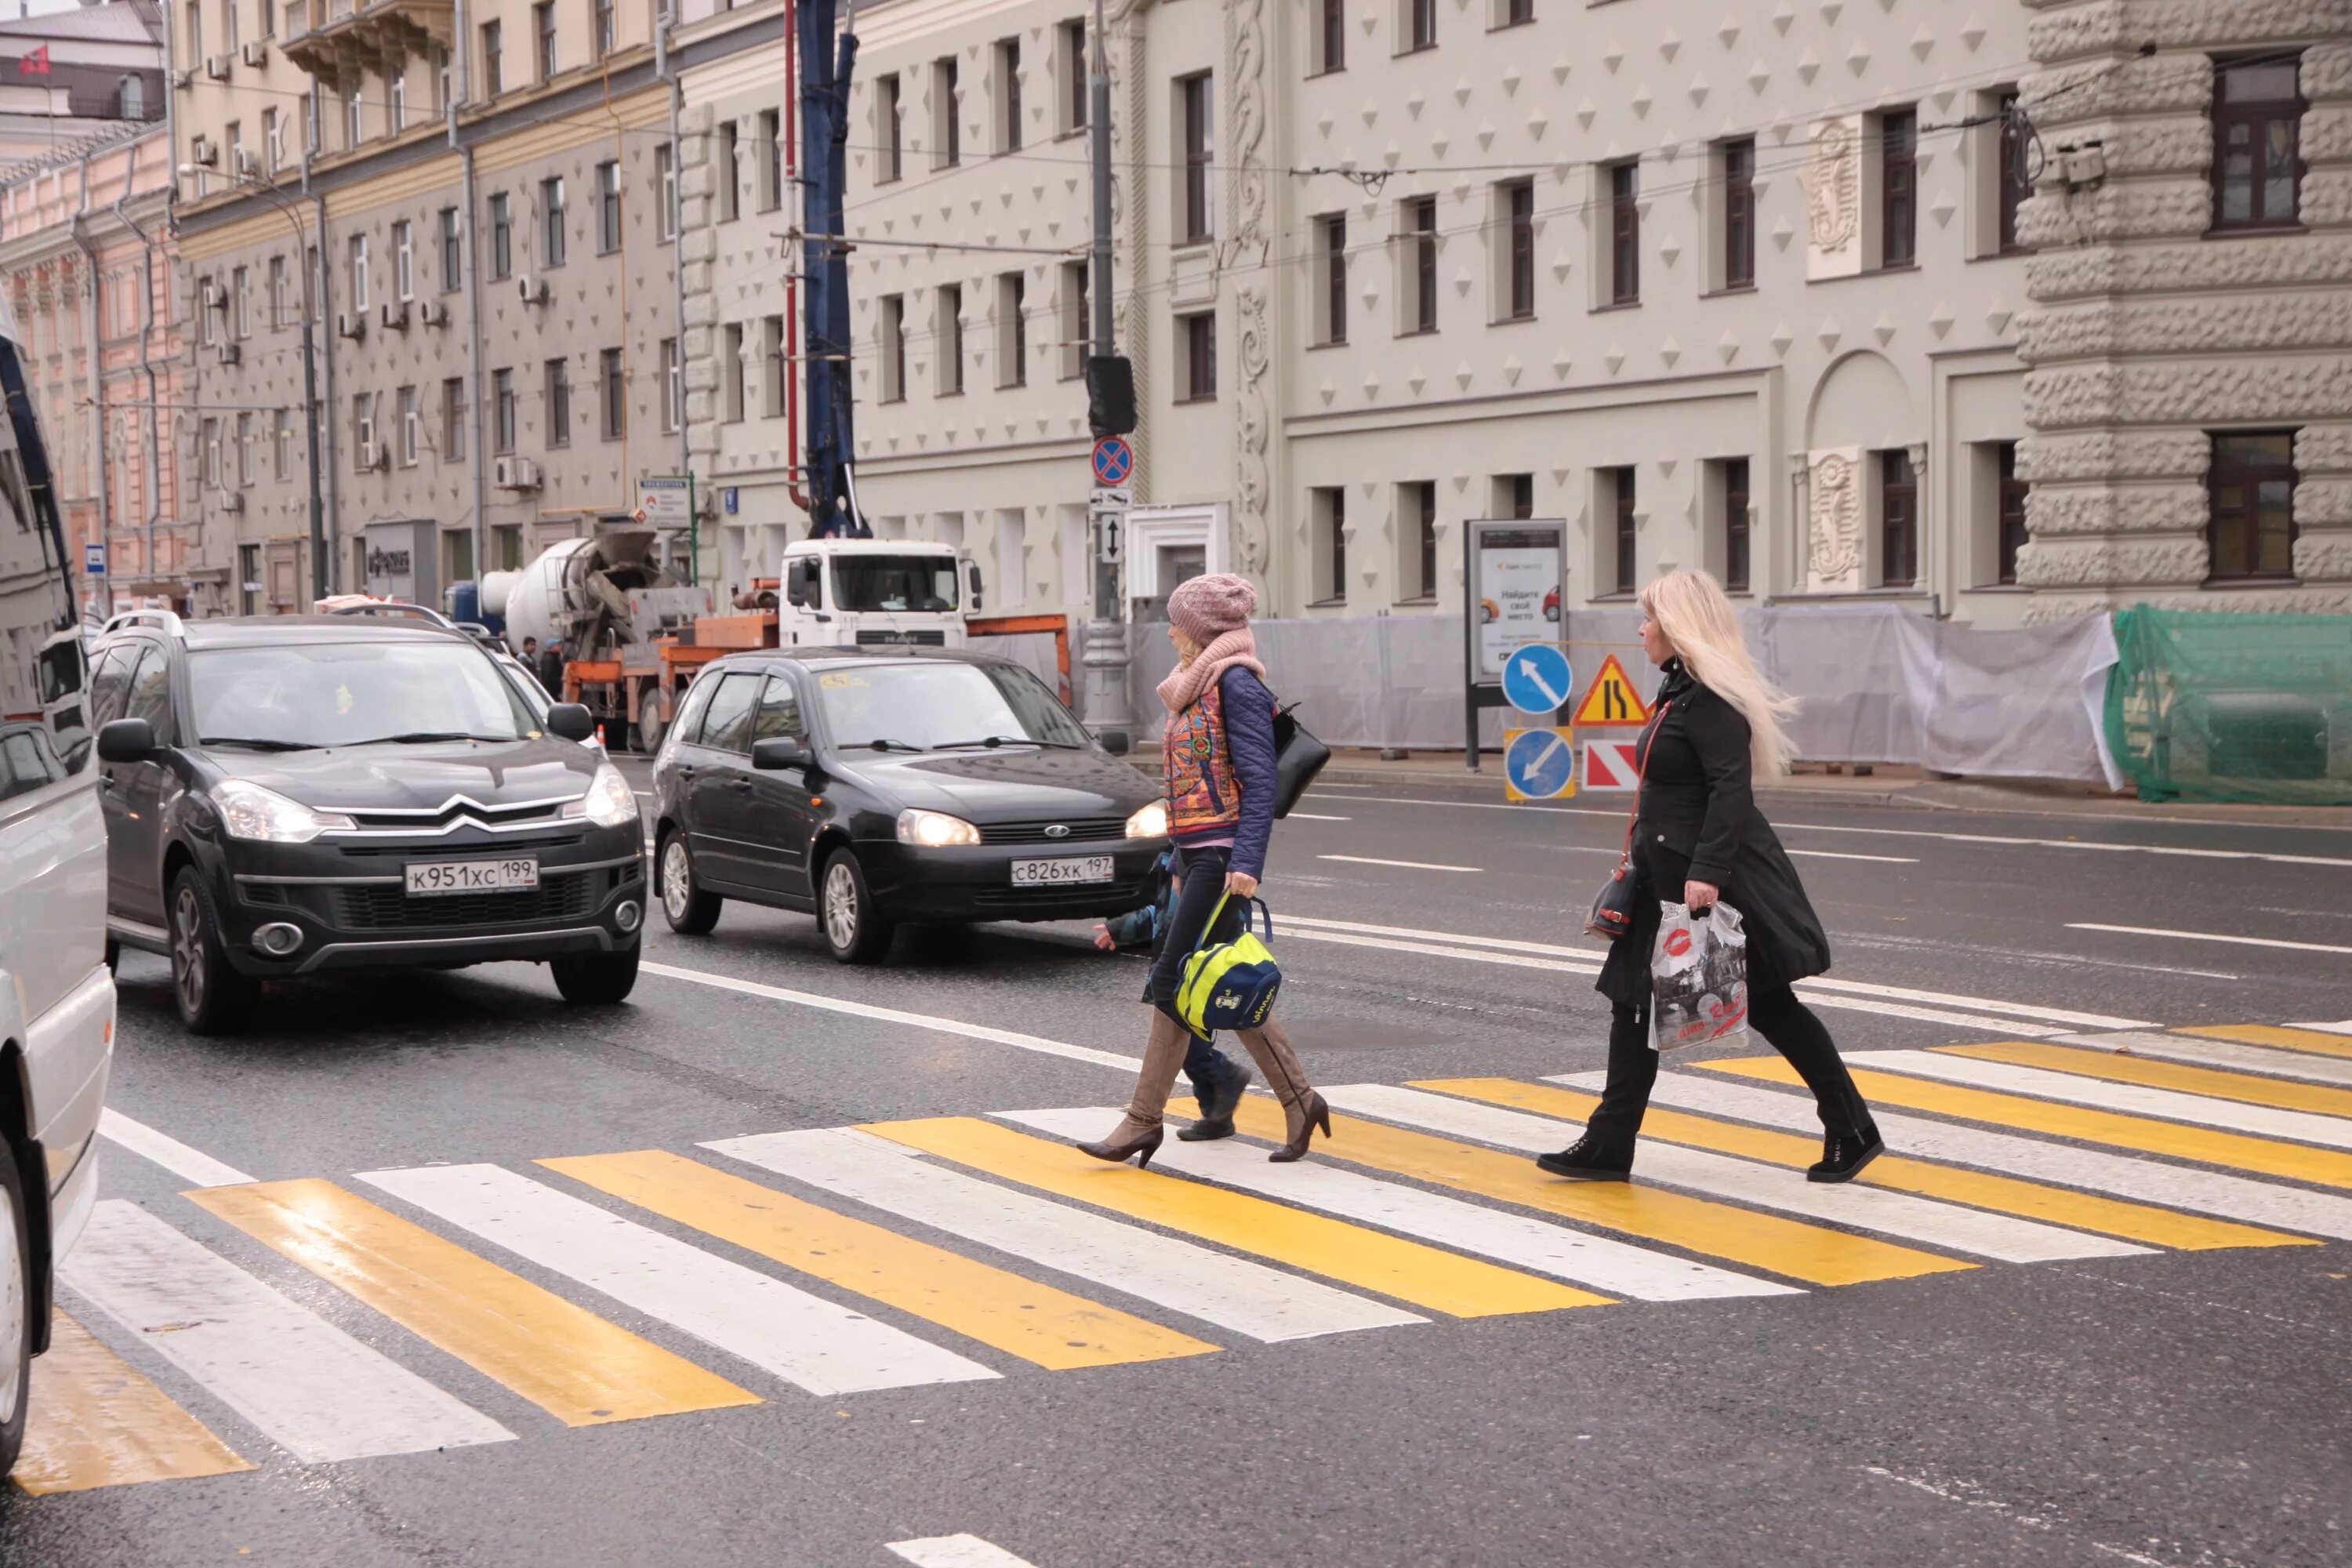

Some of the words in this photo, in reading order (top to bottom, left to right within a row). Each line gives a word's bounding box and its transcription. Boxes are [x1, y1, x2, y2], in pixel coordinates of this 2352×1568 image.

[1501, 590, 1539, 600] Найдите
[502, 861, 532, 877] 199
[1087, 858, 1110, 873] 197
